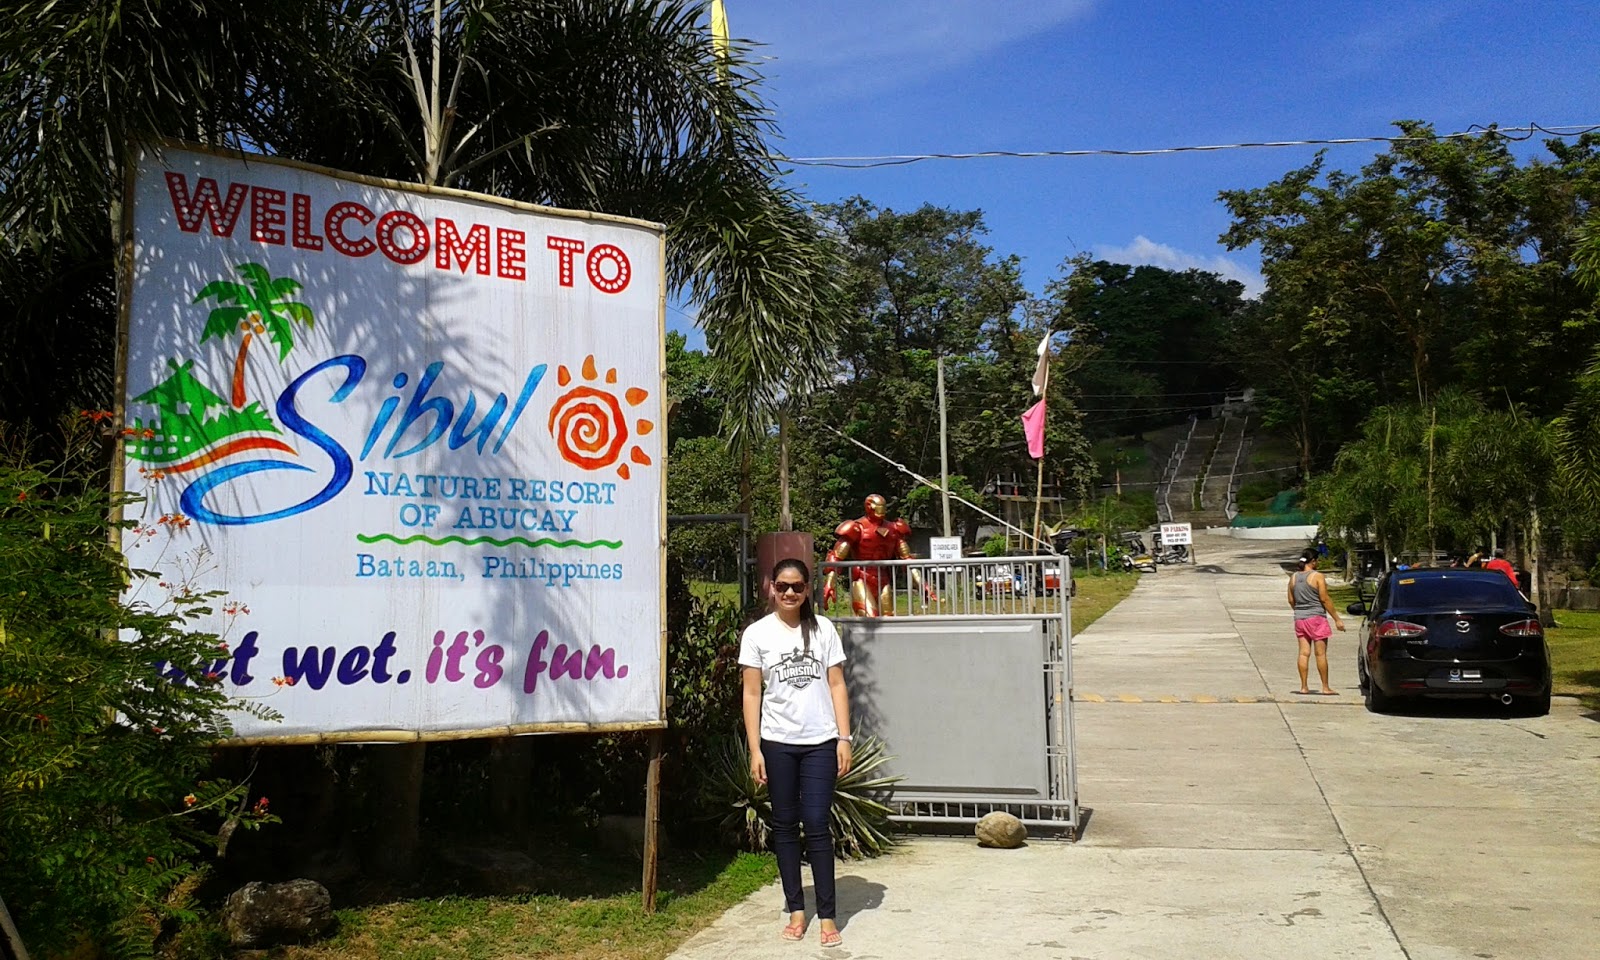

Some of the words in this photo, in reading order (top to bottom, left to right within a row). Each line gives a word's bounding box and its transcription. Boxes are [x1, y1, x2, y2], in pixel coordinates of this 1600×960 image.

[165, 172, 526, 281] WELCOME
[547, 235, 632, 295] TO
[363, 471, 502, 501] NATURE
[507, 478, 617, 505] RESORT
[400, 504, 440, 528] OF
[452, 506, 578, 533] ABUCAY
[356, 554, 465, 582] Bataan,
[481, 556, 623, 588] Philippines
[282, 631, 411, 690] wet.
[425, 630, 504, 689] it's
[523, 630, 629, 694] fun.
[775, 660, 821, 682] TURISMO
